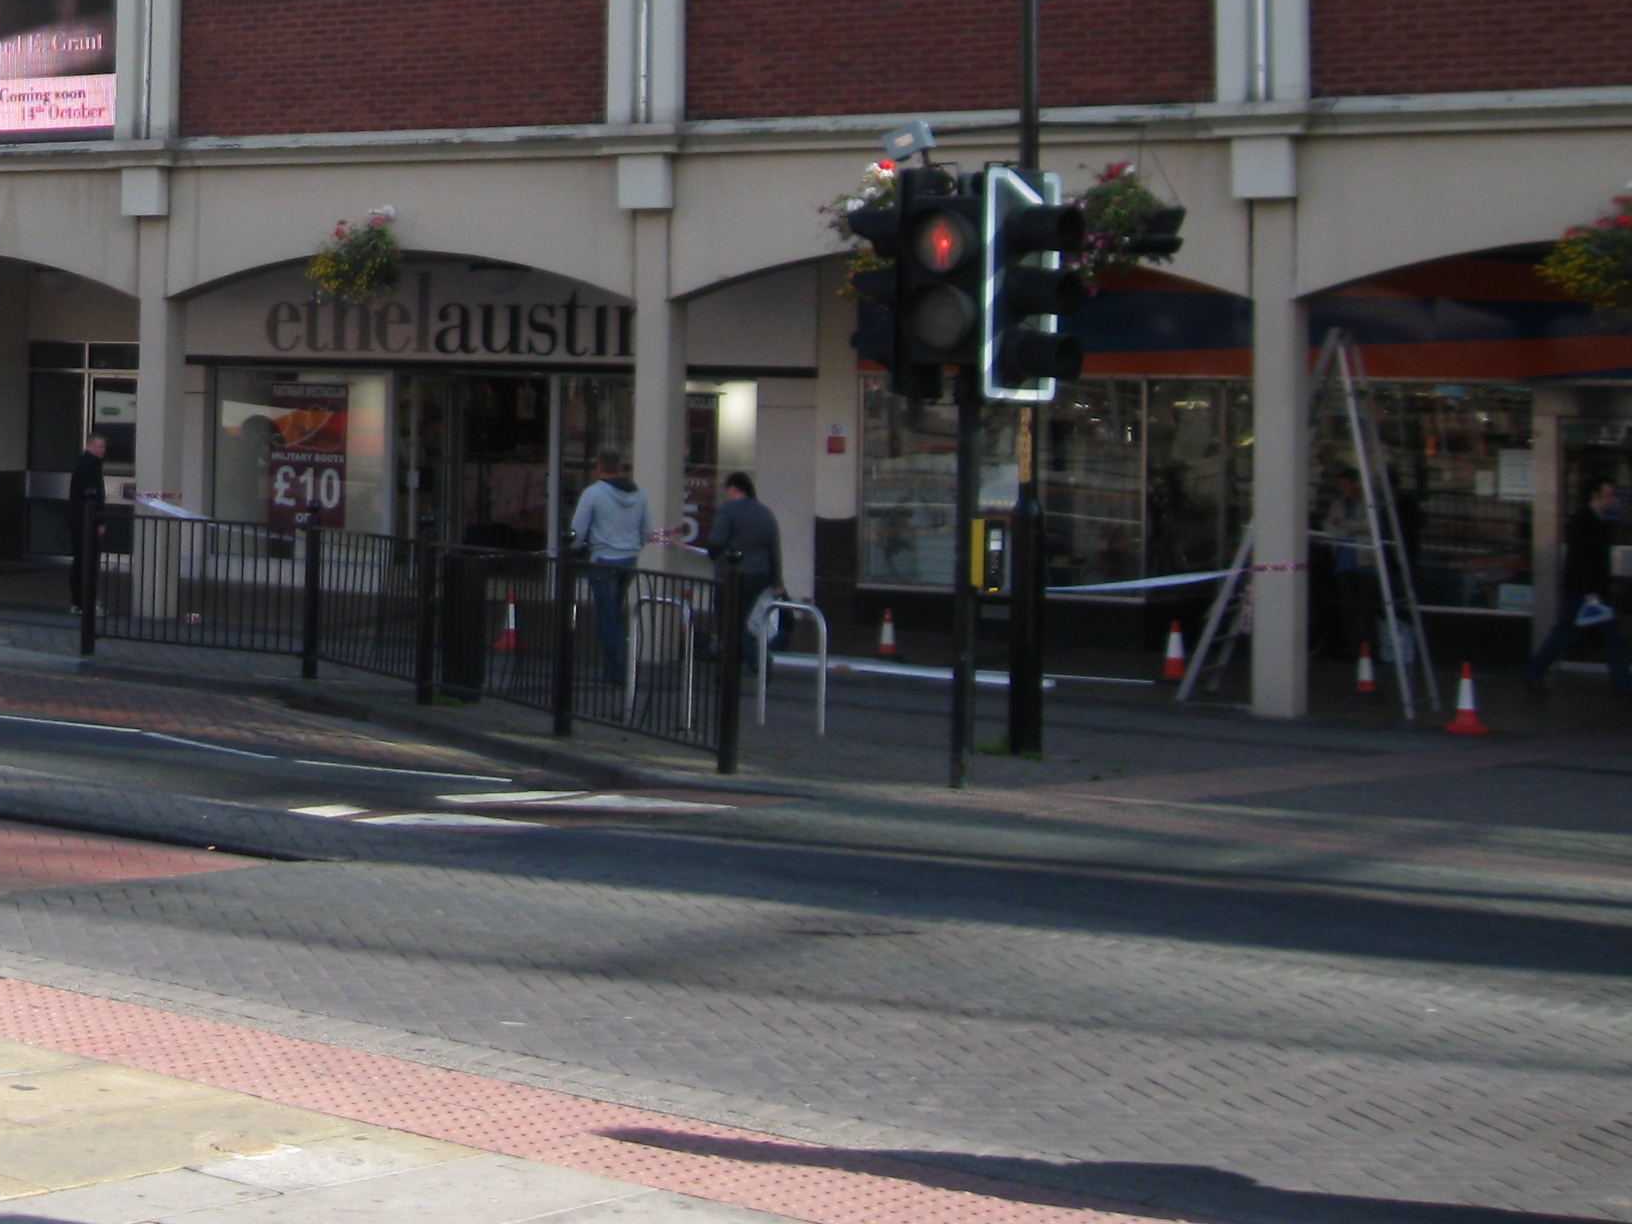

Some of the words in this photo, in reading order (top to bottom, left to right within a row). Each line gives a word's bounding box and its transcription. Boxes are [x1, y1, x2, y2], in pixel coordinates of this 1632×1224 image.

[52, 31, 104, 51] Grant
[0, 87, 51, 105] Coming
[54, 89, 87, 100] soon
[48, 103, 106, 121] October
[271, 452, 312, 463] MILITARY
[314, 453, 345, 464] BOOTS
[274, 465, 341, 510] £10
